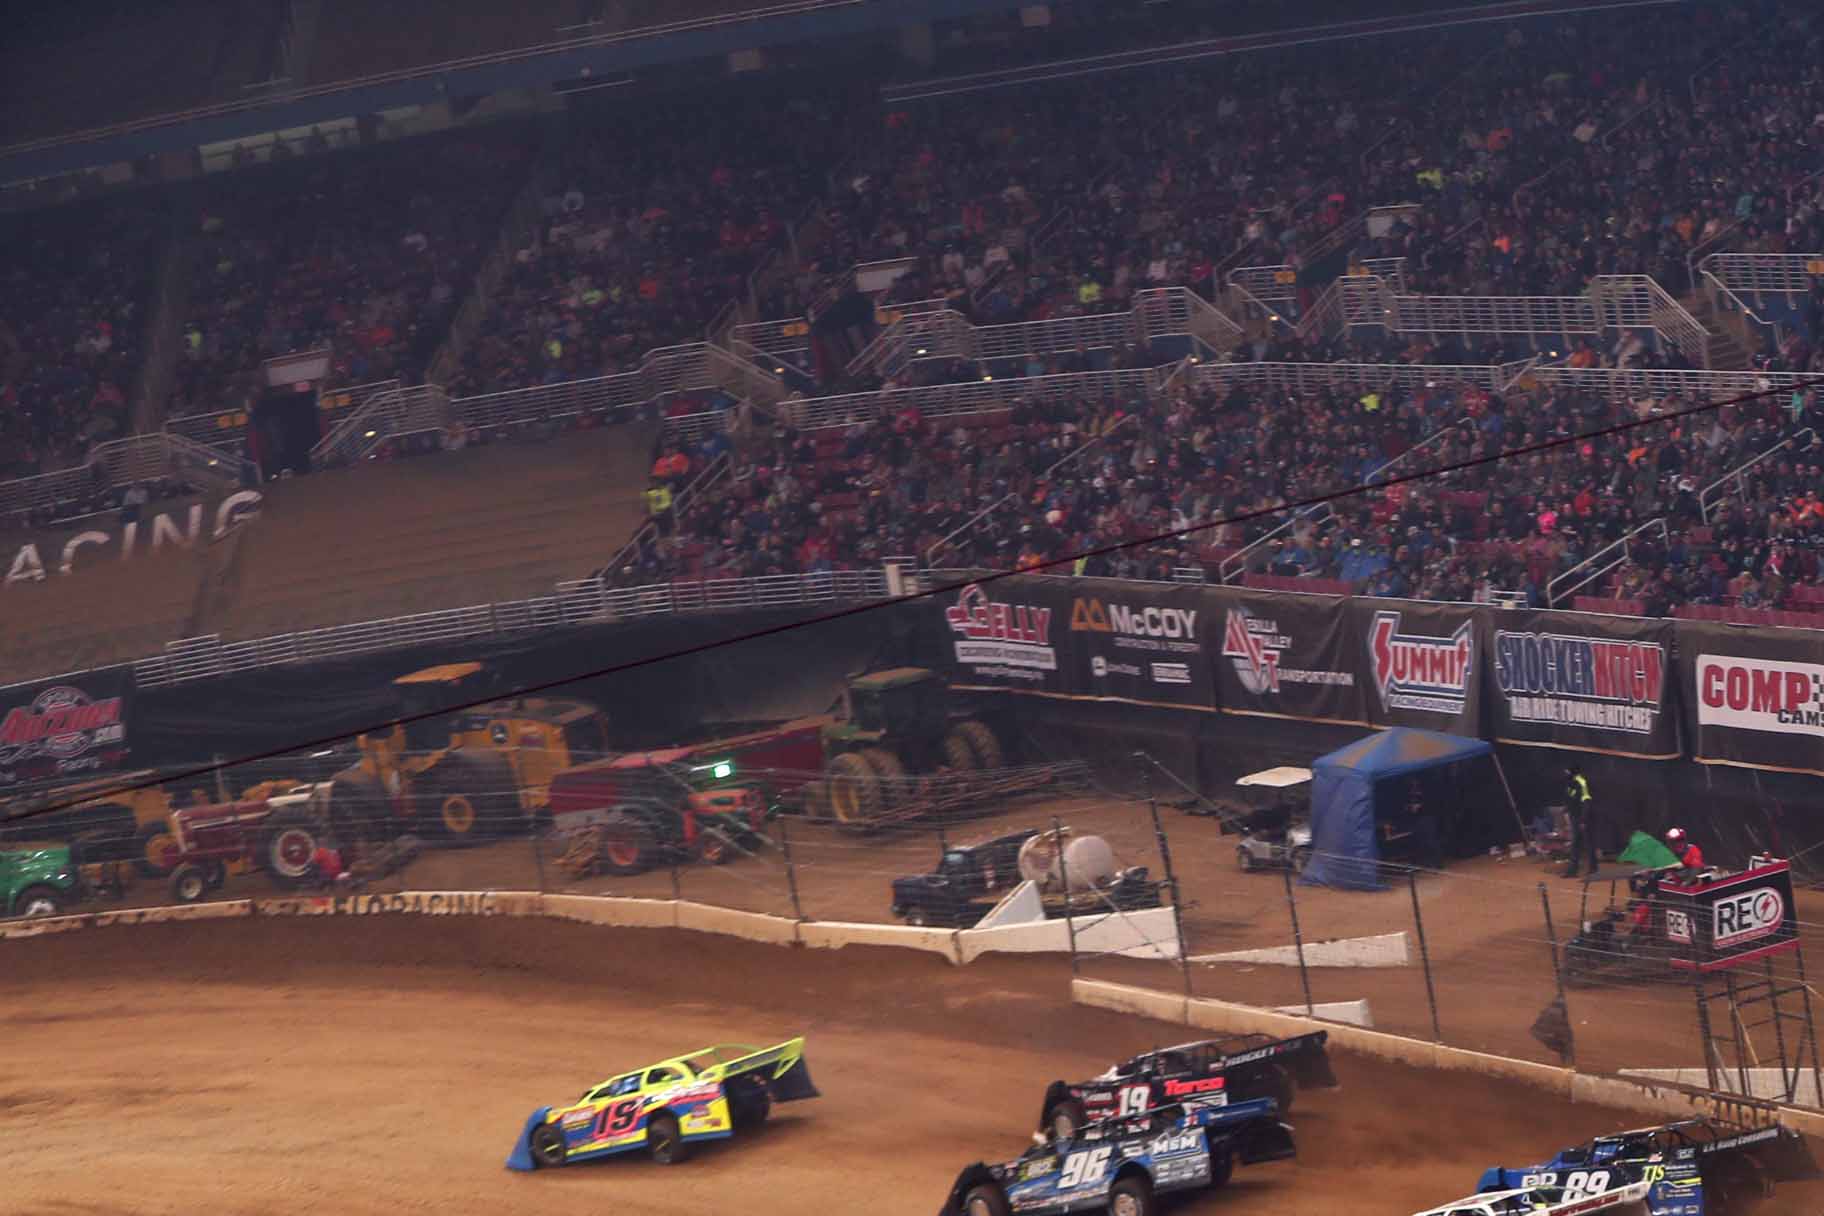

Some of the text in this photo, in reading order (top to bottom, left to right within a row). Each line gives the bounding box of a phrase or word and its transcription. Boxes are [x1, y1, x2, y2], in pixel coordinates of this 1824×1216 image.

[1109, 603, 1198, 639] McCOY
[1374, 617, 1469, 691] SUMMIT
[1703, 664, 1810, 713] COMP
[1118, 1085, 1150, 1118] 19
[1056, 1146, 1112, 1189] 96
[1561, 1171, 1609, 1204] 89
